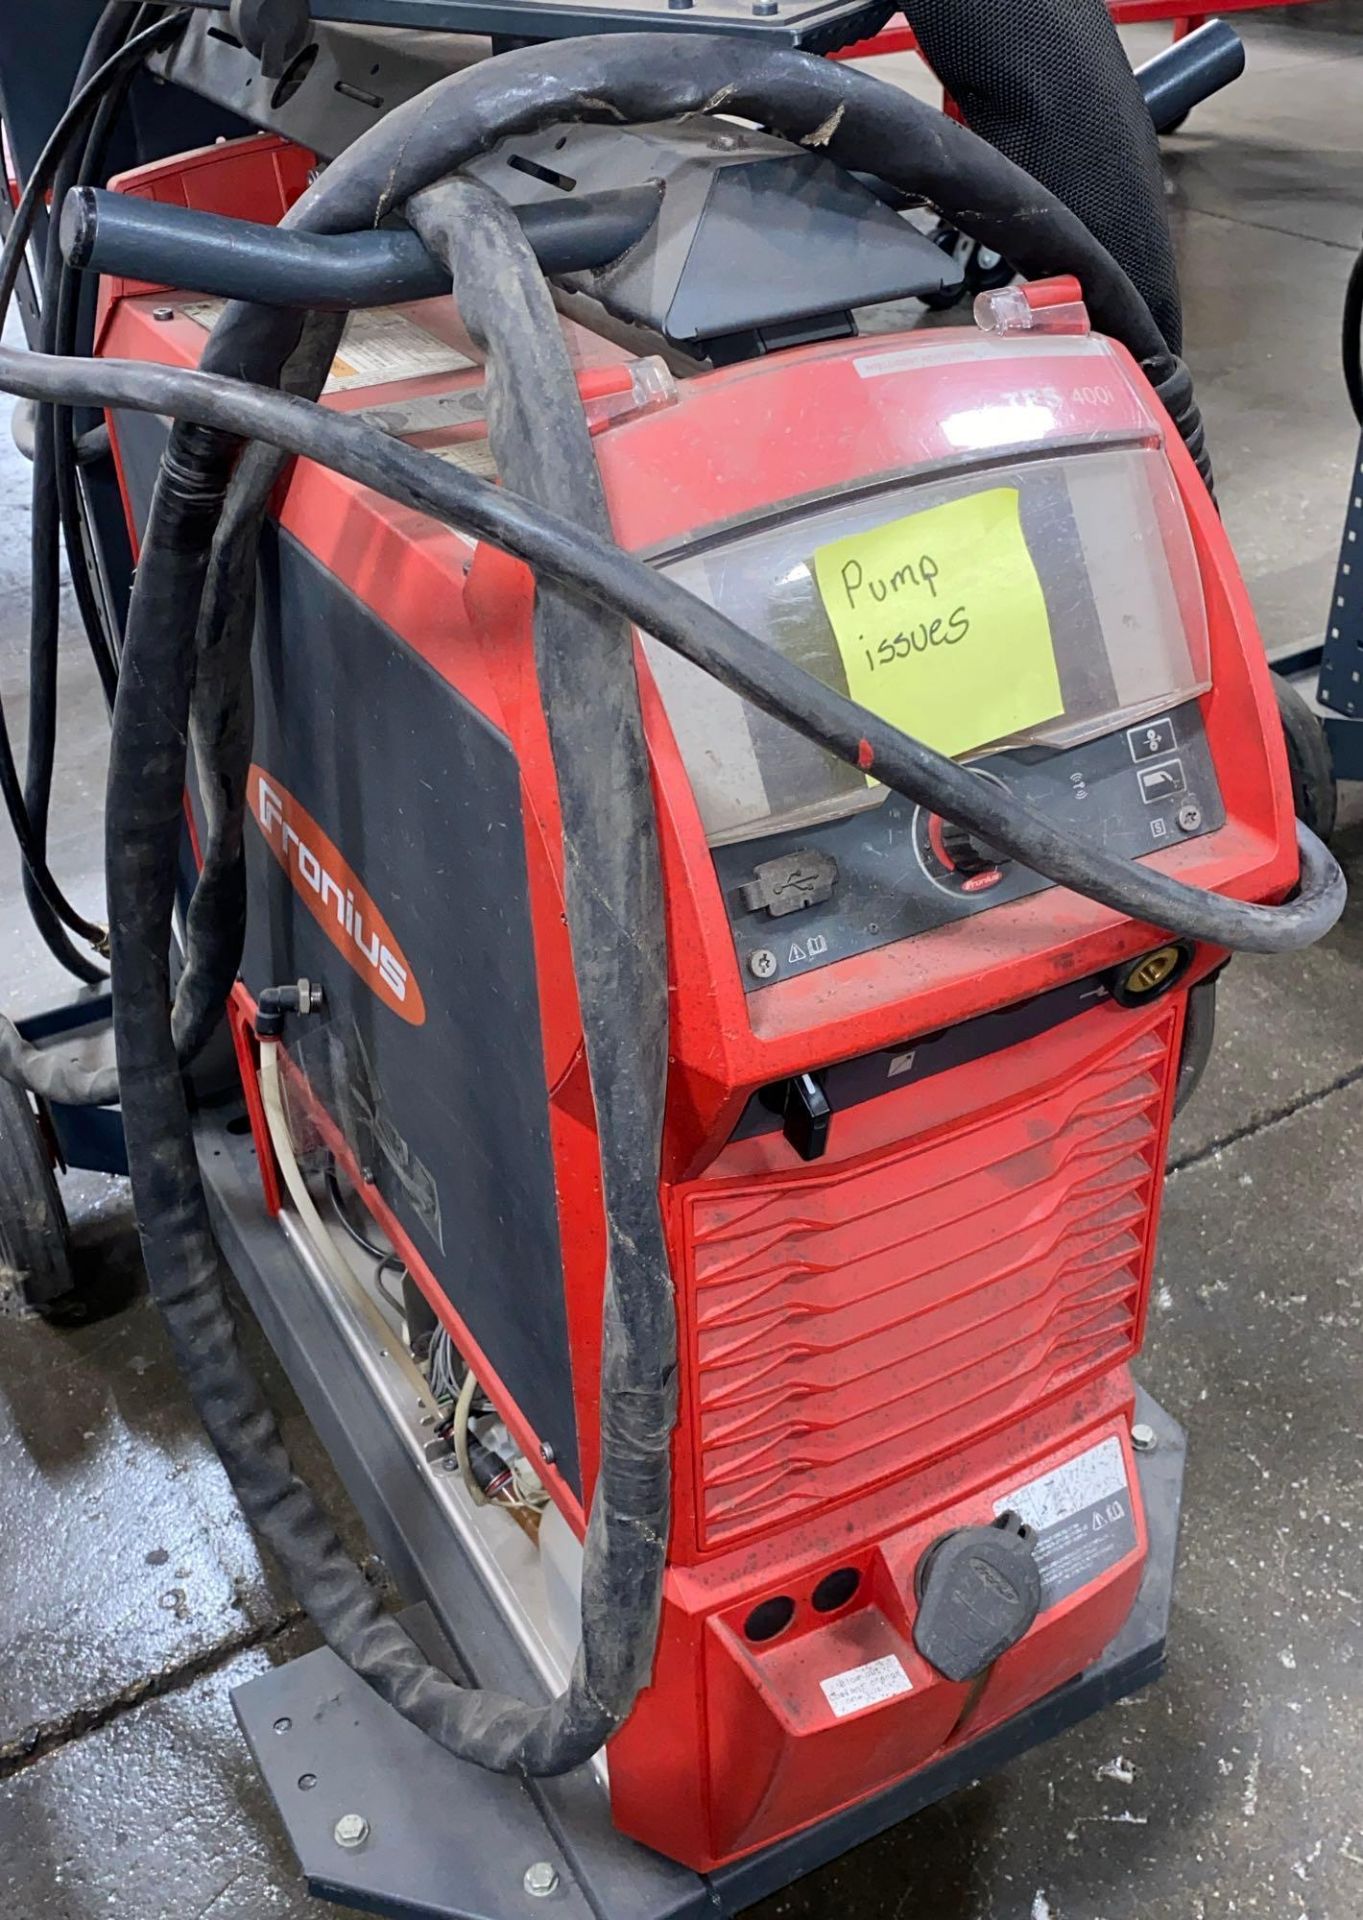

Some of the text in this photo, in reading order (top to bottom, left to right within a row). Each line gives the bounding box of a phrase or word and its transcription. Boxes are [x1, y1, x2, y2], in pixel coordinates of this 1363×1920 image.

[1072, 386, 1114, 407] 400i
[841, 555, 939, 609] Pump
[858, 606, 970, 671] issues
[258, 776, 407, 1002] Fronius
